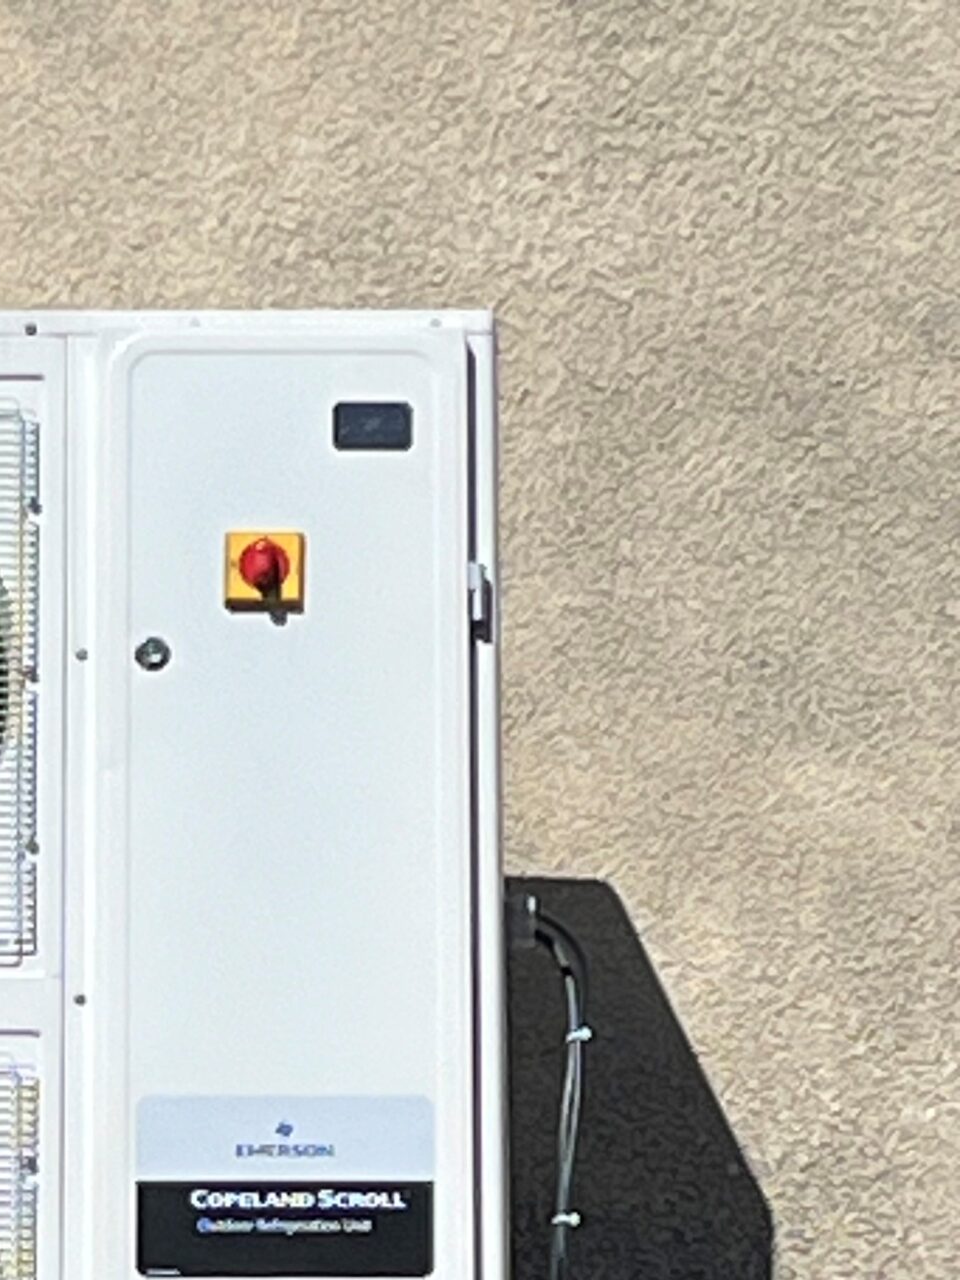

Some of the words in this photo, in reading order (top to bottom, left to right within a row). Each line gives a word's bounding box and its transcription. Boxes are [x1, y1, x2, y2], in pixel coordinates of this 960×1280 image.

[236, 1145, 335, 1157] EMERSON
[190, 1189, 314, 1208] COPELAND
[318, 1189, 406, 1208] SCROLL
